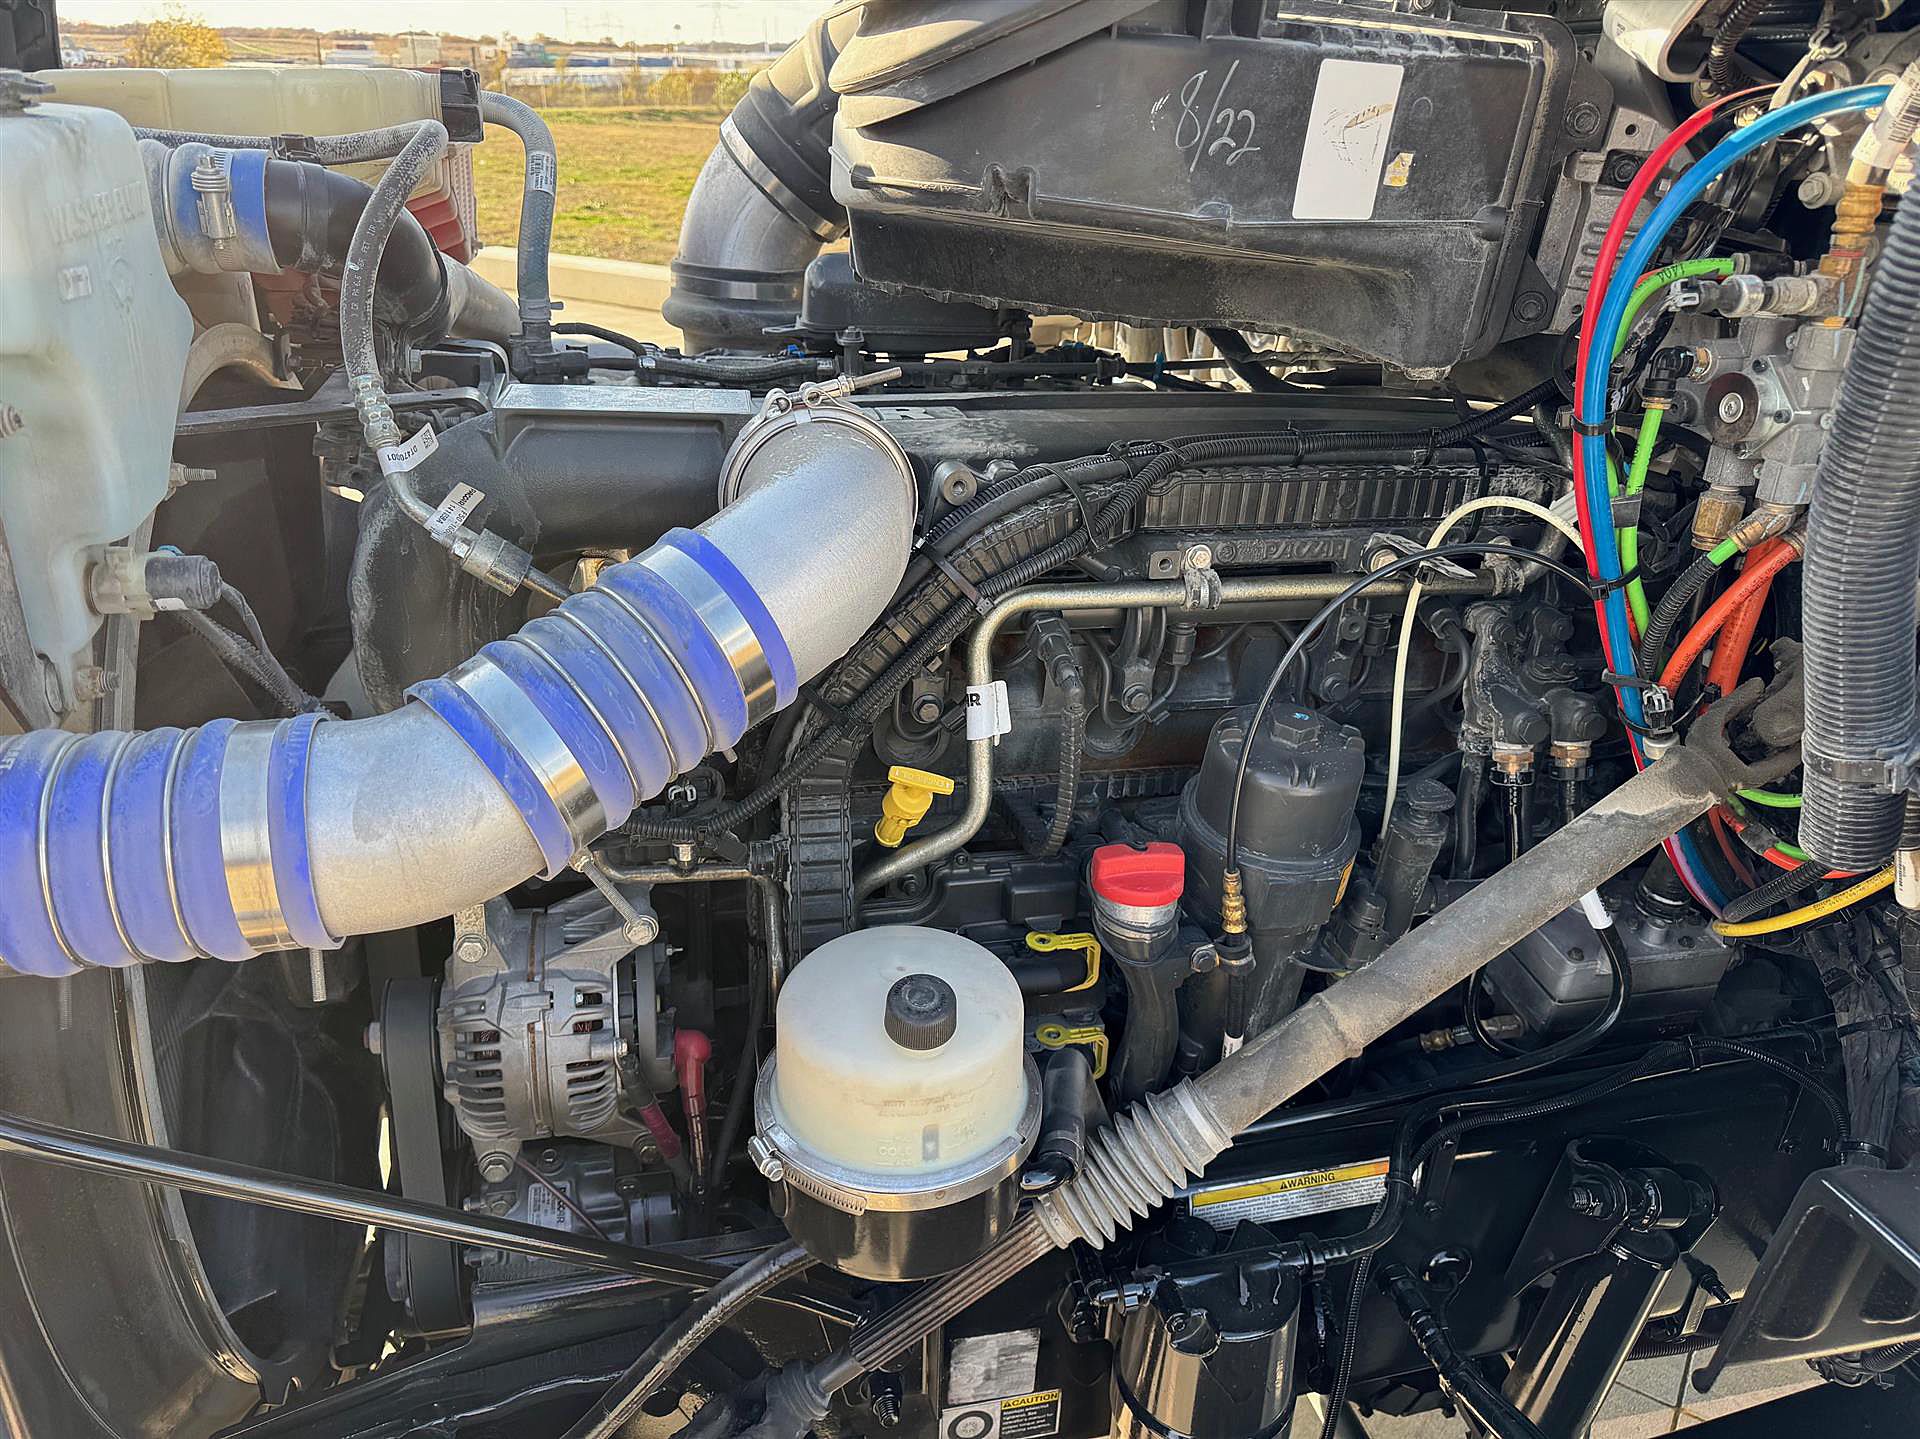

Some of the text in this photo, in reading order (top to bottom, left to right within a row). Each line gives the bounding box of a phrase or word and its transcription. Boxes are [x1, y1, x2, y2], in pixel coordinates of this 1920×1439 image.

[1175, 60, 1260, 173] 8/22
[1287, 1172, 1335, 1189] WARNING
[1012, 1392, 1058, 1407] CAUTION
